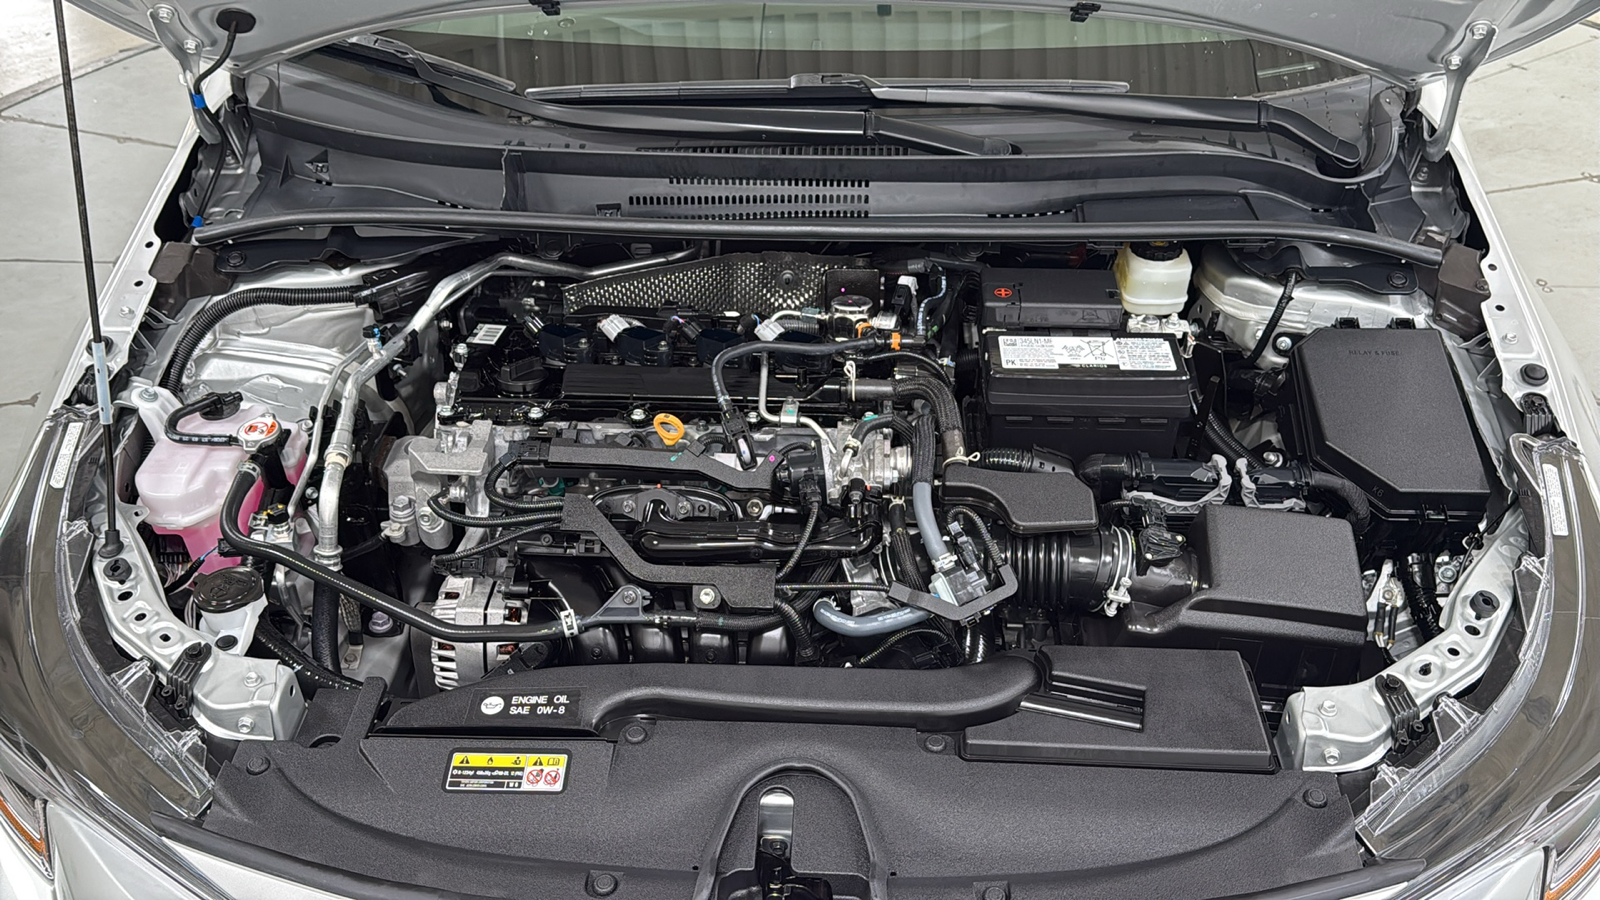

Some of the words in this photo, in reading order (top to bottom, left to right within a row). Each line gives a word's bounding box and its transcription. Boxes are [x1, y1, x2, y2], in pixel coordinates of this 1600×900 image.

[511, 695, 549, 704] ENGINE
[553, 694, 570, 704] OIL
[509, 706, 531, 715] SAE
[536, 706, 566, 715] 0W-8
